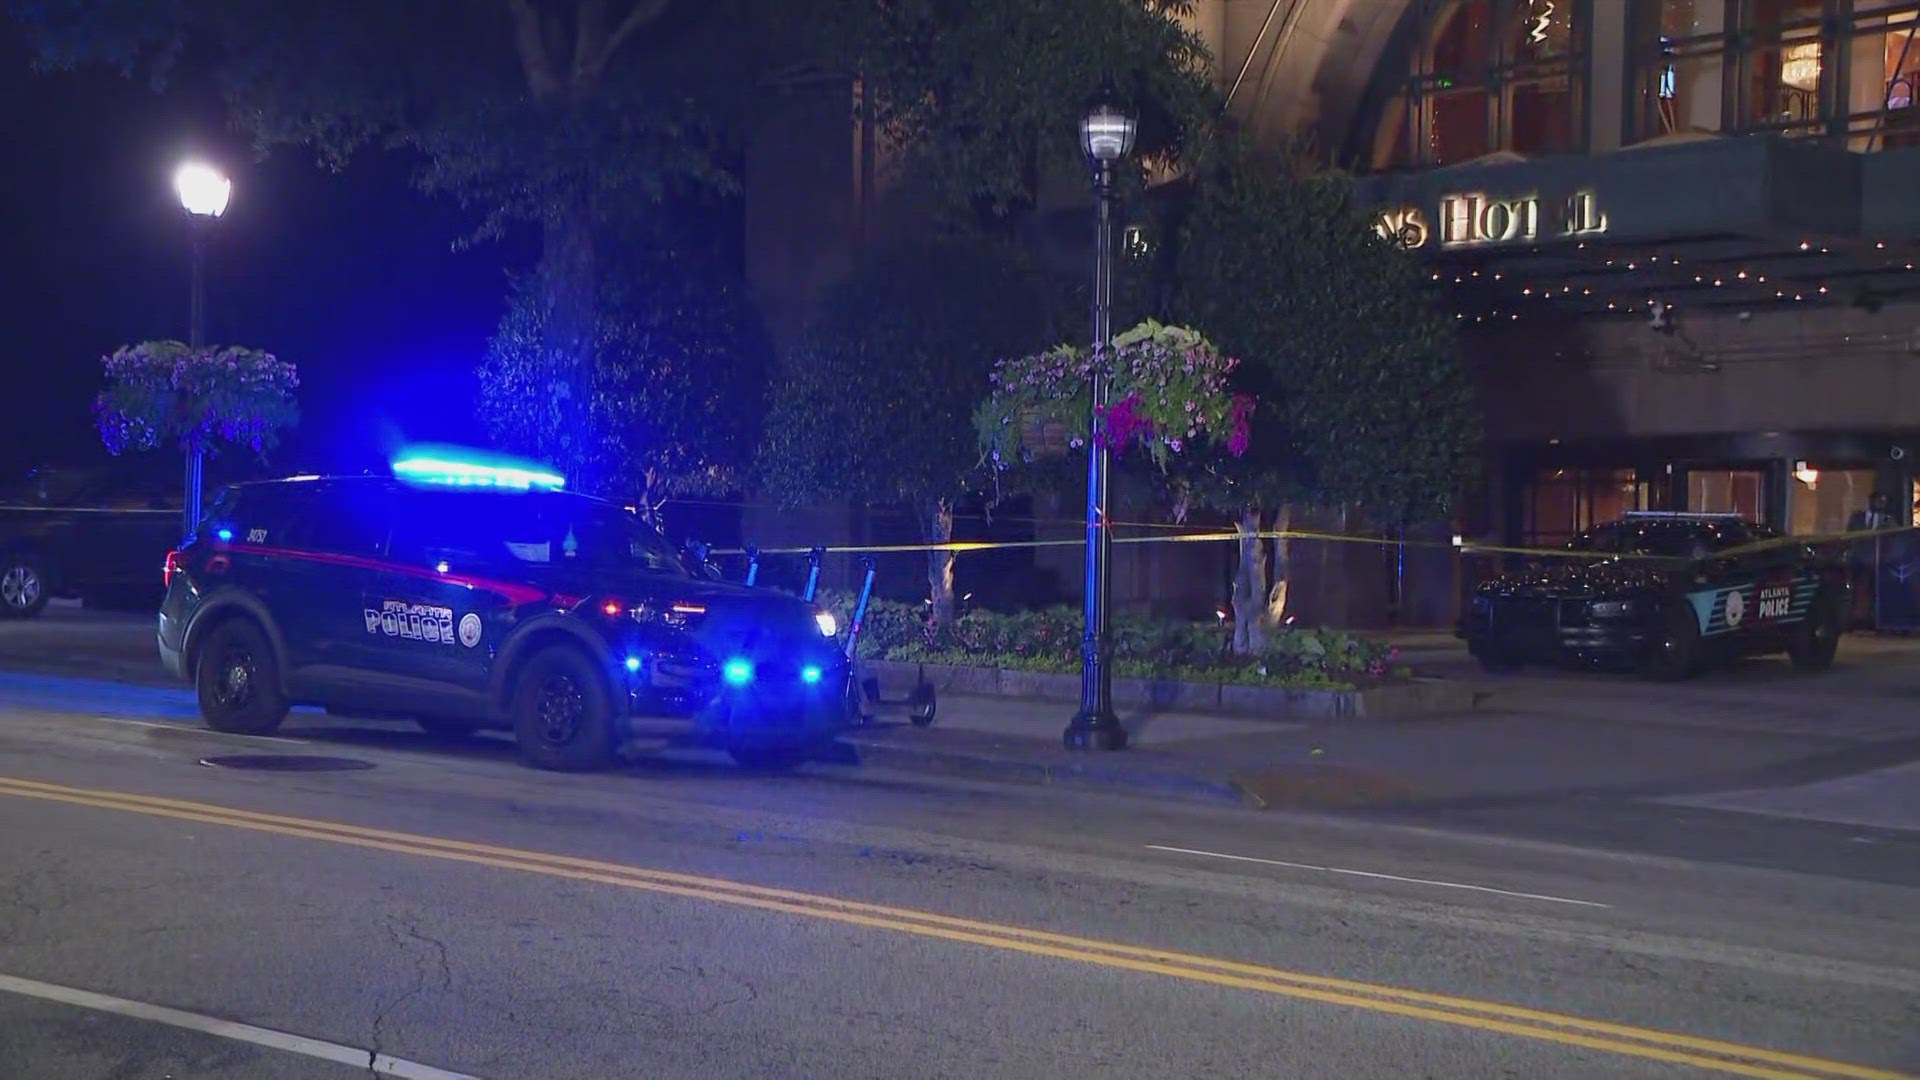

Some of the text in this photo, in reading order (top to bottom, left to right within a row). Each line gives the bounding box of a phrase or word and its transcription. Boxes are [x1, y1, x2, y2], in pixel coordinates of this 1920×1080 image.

[1441, 194, 1608, 243] HOTL
[1761, 587, 1790, 599] ATLANTA
[1759, 598, 1789, 618] POLICE
[364, 609, 455, 644] POLICE
